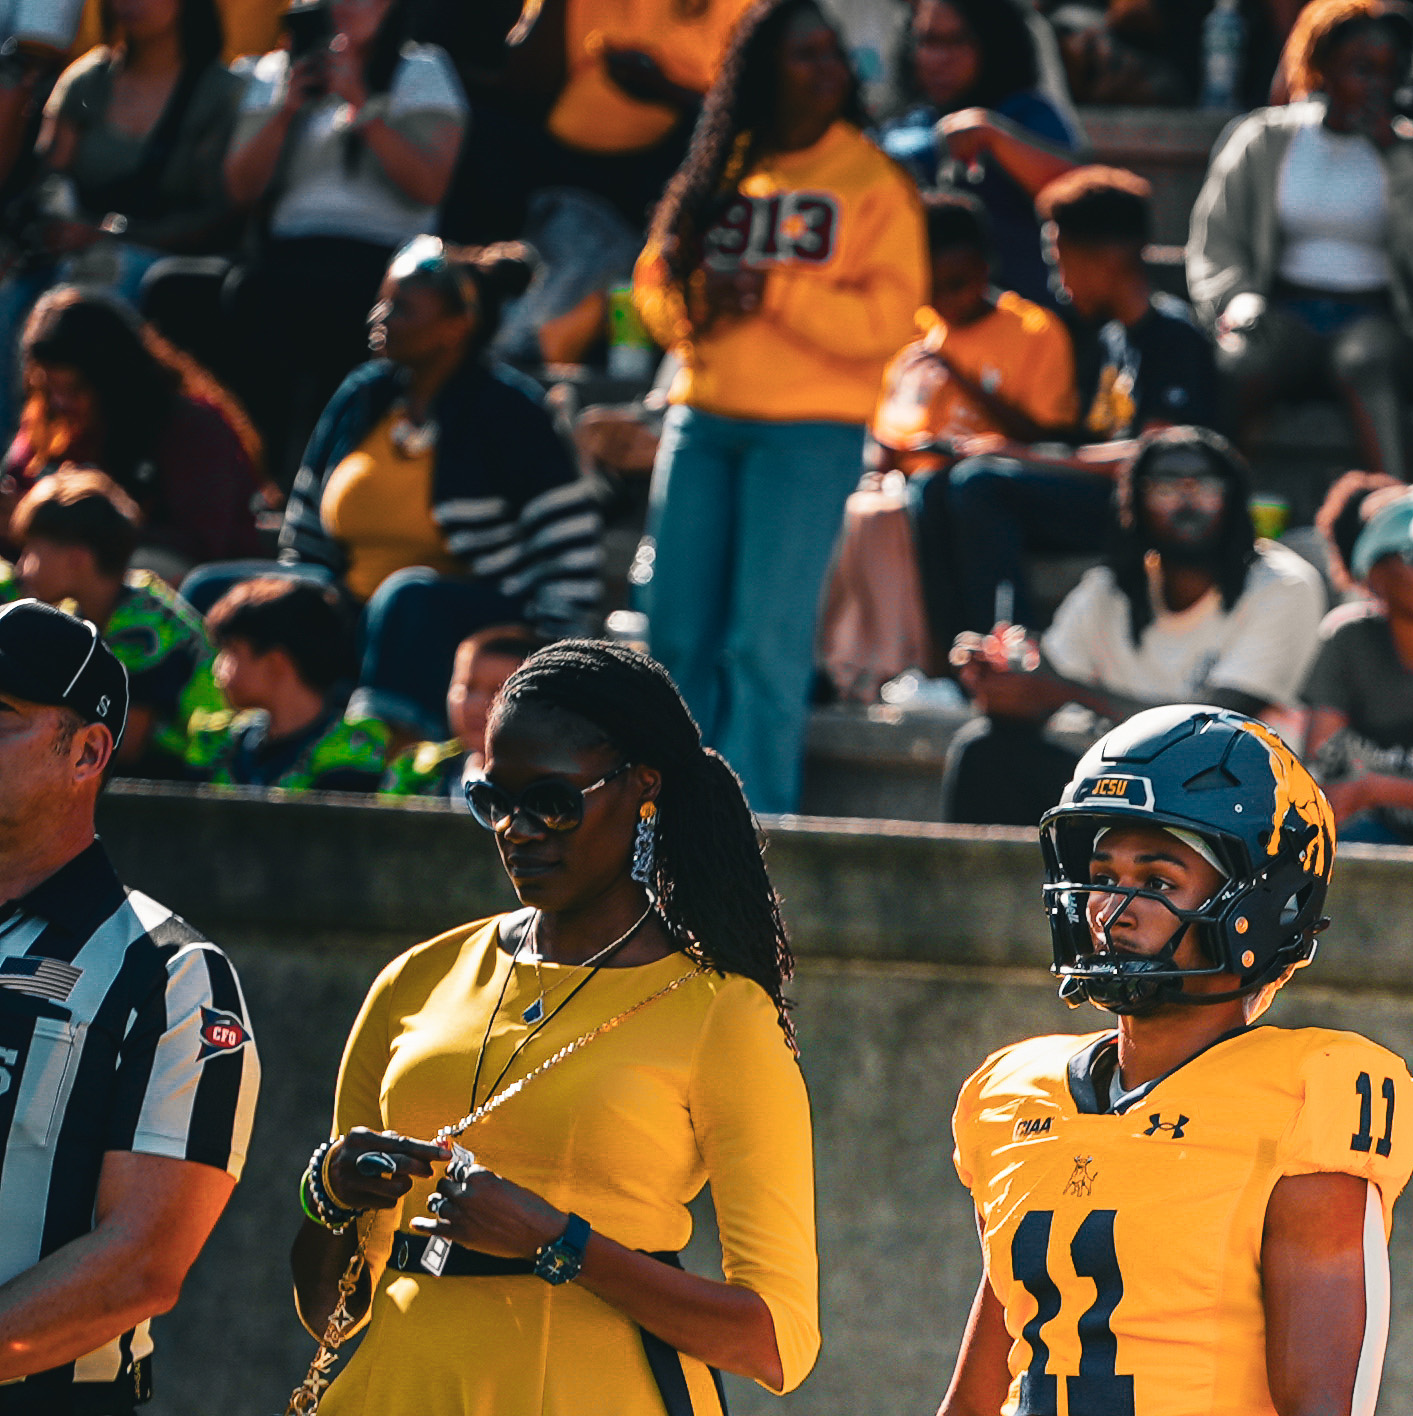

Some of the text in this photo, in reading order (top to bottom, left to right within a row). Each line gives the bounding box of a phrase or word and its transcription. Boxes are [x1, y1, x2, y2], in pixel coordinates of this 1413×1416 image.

[1091, 779, 1128, 796] JCSU
[212, 1025, 237, 1046] CFO
[1349, 1071, 1395, 1159] 11
